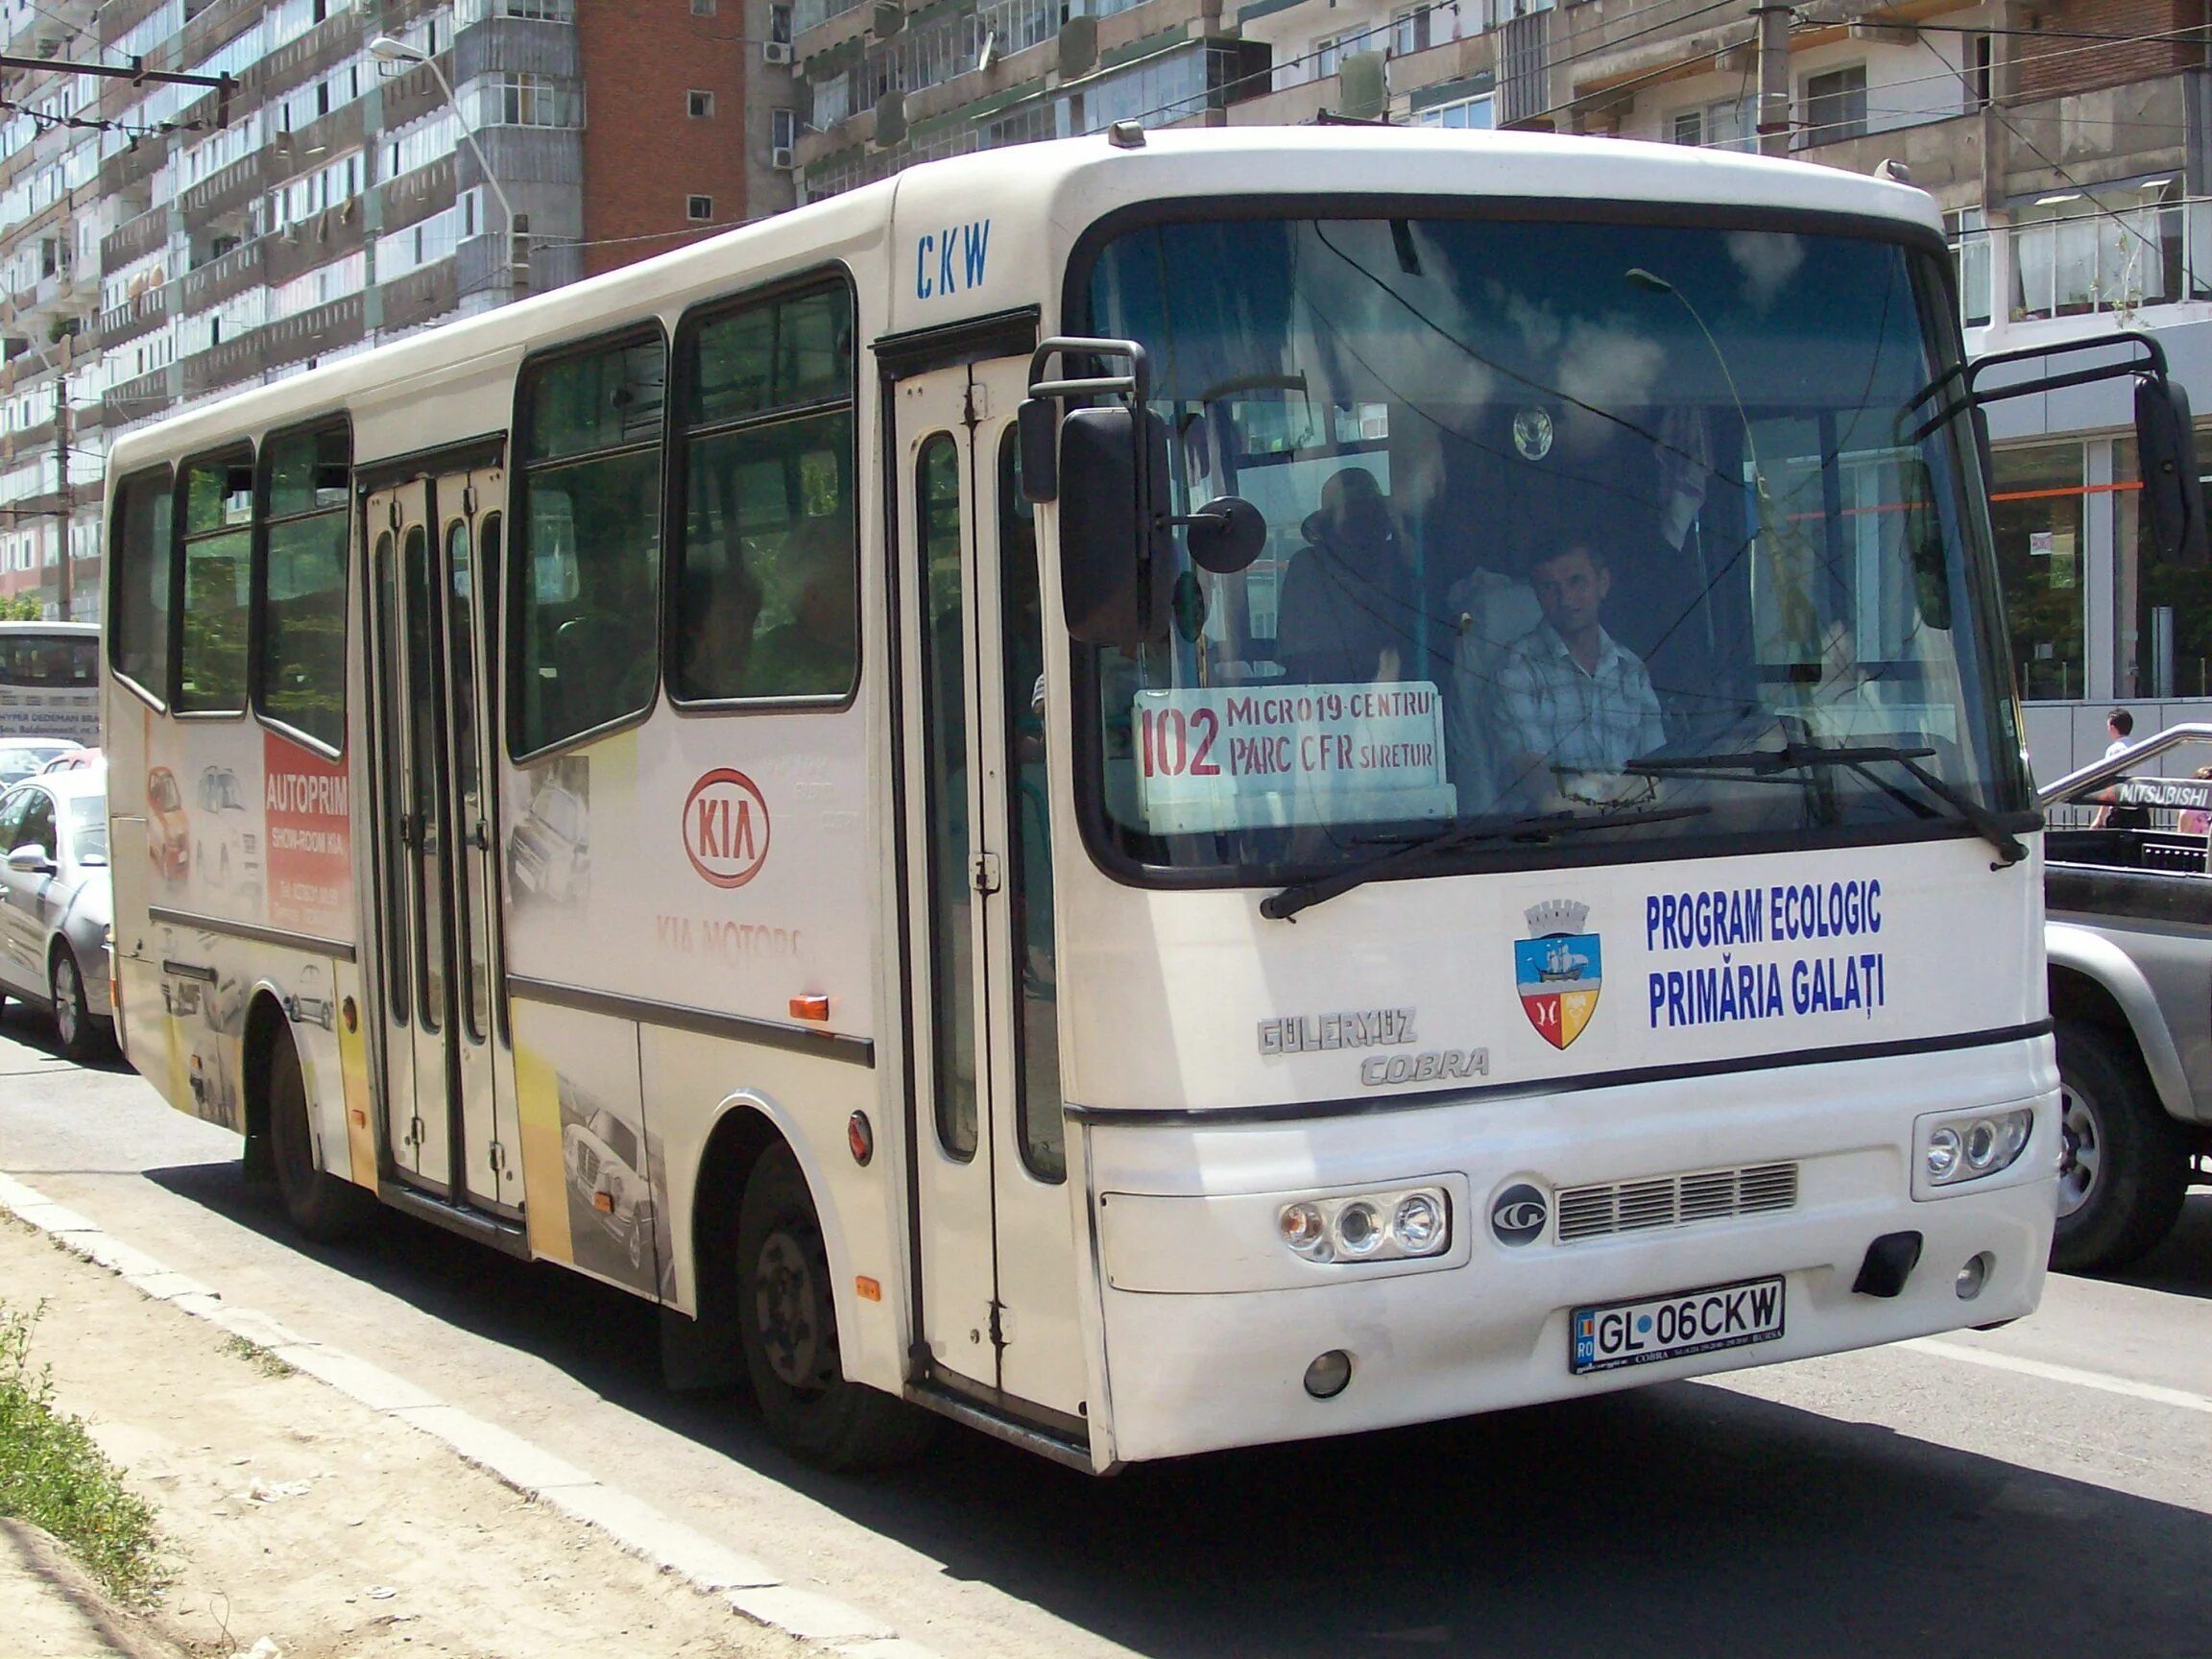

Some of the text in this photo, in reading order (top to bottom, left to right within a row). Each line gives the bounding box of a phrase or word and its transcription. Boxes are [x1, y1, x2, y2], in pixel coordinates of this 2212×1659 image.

[917, 219, 990, 299] CKW
[1142, 708, 1220, 777] 102
[1229, 735, 1292, 776] PARC
[1301, 733, 1353, 771] CFR
[266, 773, 349, 816] AUTOPRIM
[2119, 783, 2208, 806] MITSUBISHI
[698, 799, 756, 859] KIA
[656, 915, 694, 953] KIA
[1647, 878, 1882, 951] PROGRAM ECOLOGIC
[1648, 952, 1784, 1028] PRIMĂRIA
[1359, 1047, 1490, 1087] COBRA
[1577, 1342, 1594, 1358] RO
[1599, 1311, 1645, 1354] GL
[1635, 1351, 1669, 1363] COBRA
